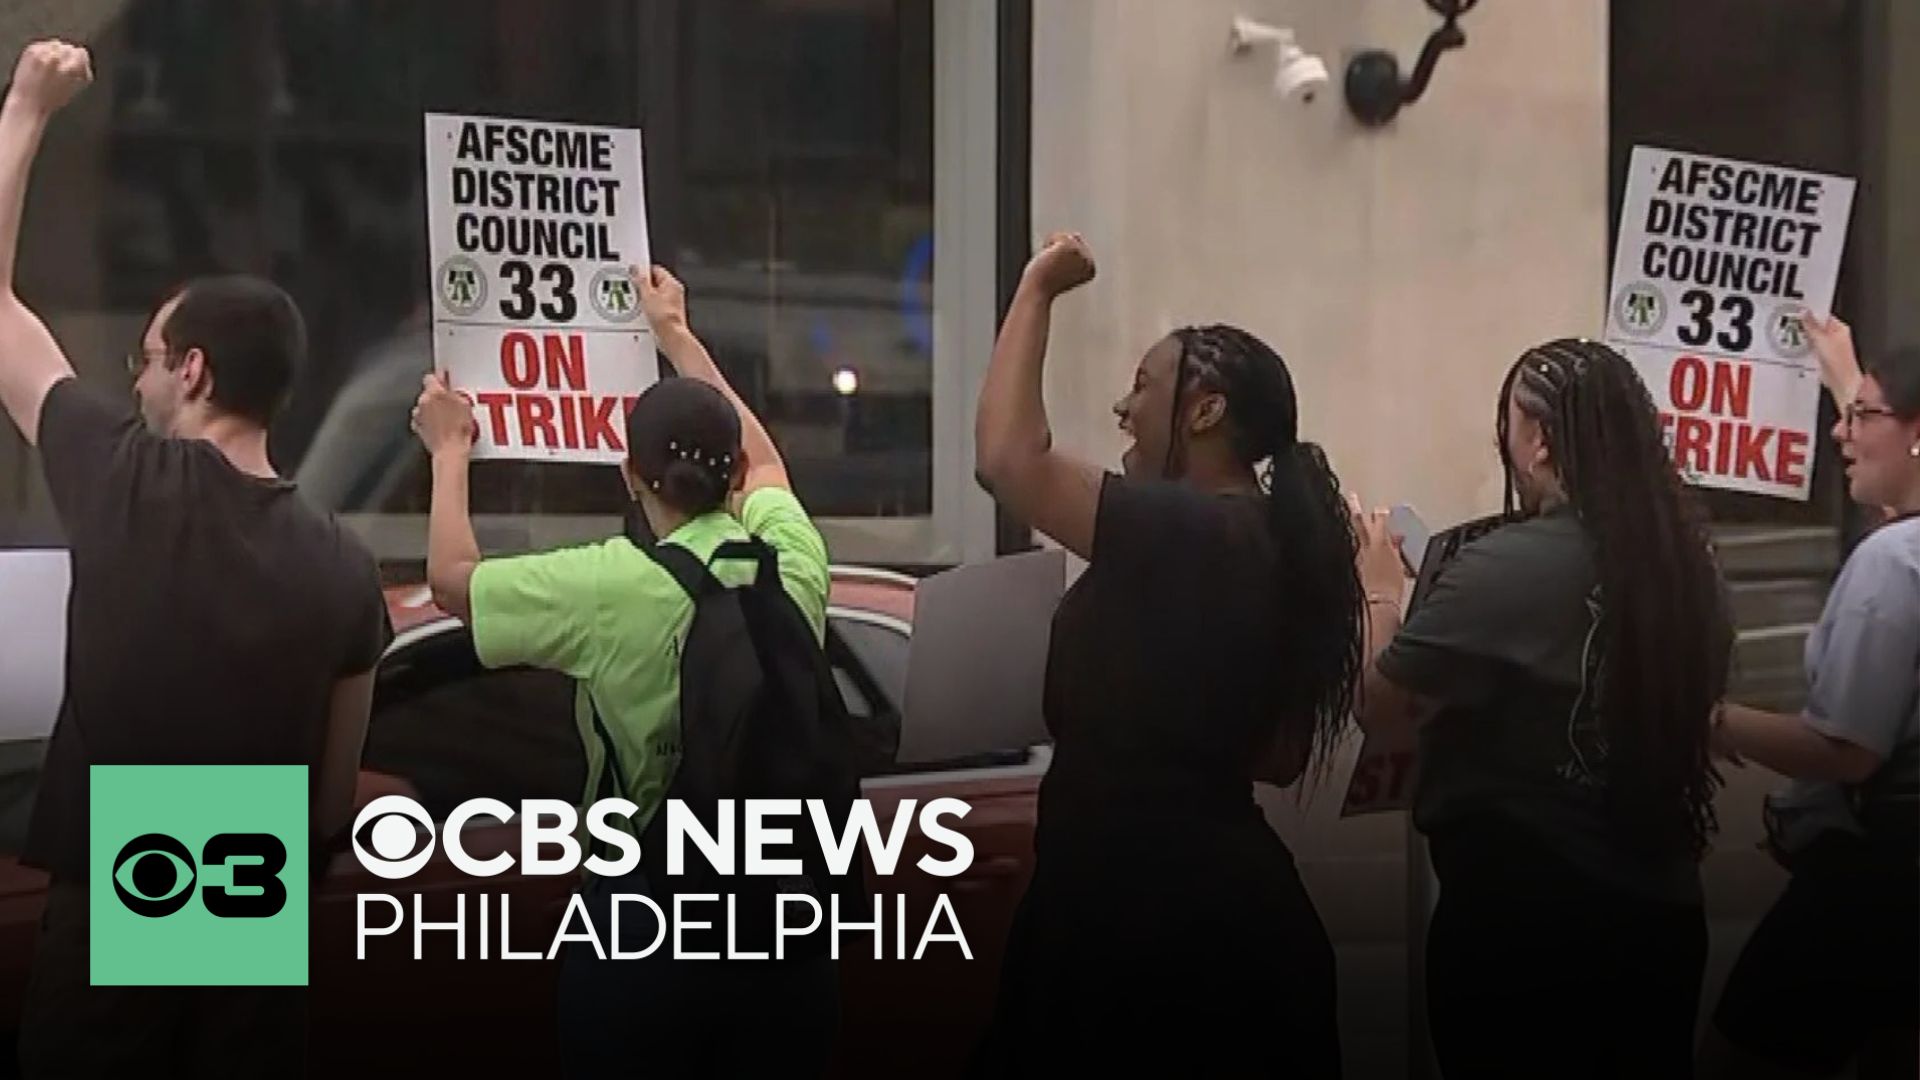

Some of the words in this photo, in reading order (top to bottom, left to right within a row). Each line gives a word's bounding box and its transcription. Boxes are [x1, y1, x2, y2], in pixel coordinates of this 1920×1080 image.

[457, 122, 612, 172] AFSCME
[452, 167, 620, 217] DISTRICT
[1658, 157, 1823, 215] AFSCME
[456, 212, 620, 261] COUNCIL
[1646, 199, 1822, 258] DISTRICT
[499, 260, 578, 323] 33
[1643, 241, 1804, 299] COUNCIL
[1676, 289, 1755, 352] 33
[501, 331, 588, 392] ON
[1669, 356, 1752, 418] ON
[457, 391, 642, 452] TRIK
[1658, 412, 1809, 487] RIKE
